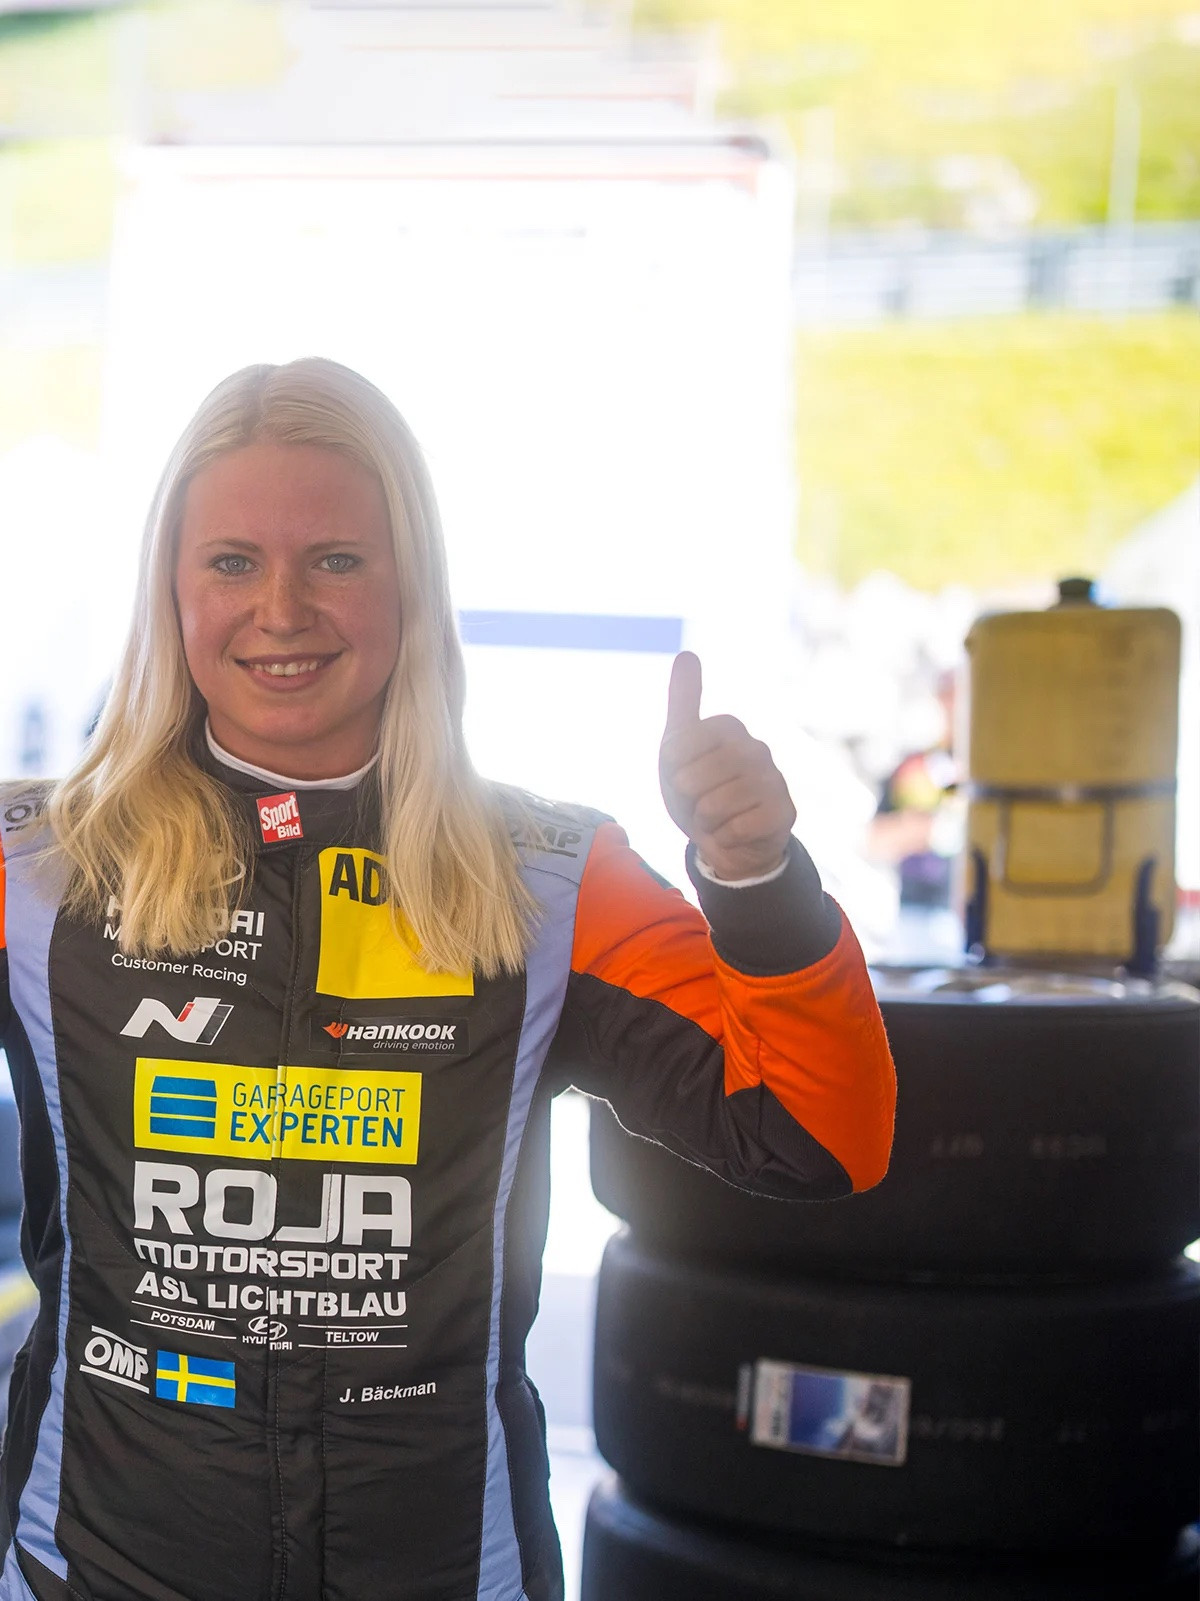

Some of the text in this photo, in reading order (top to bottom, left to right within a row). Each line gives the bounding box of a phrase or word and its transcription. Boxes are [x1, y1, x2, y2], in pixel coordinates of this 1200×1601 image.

[260, 795, 299, 832] Sport
[277, 823, 301, 838] Bild
[329, 853, 389, 906] AD
[111, 953, 248, 986] Customer Racing
[373, 1041, 455, 1051] driving emotion
[233, 1082, 406, 1113] GARAGEPORT
[230, 1111, 403, 1148] EXPERTEN
[134, 1161, 412, 1247] ROJA
[134, 1238, 409, 1280] MOTORSPORT
[135, 1271, 407, 1317] ASL LICHTBLAU
[150, 1310, 216, 1331] POTSDAM
[325, 1331, 379, 1343] TELTOW
[84, 1336, 149, 1381] OMP
[339, 1381, 436, 1403] J. Bäckman
